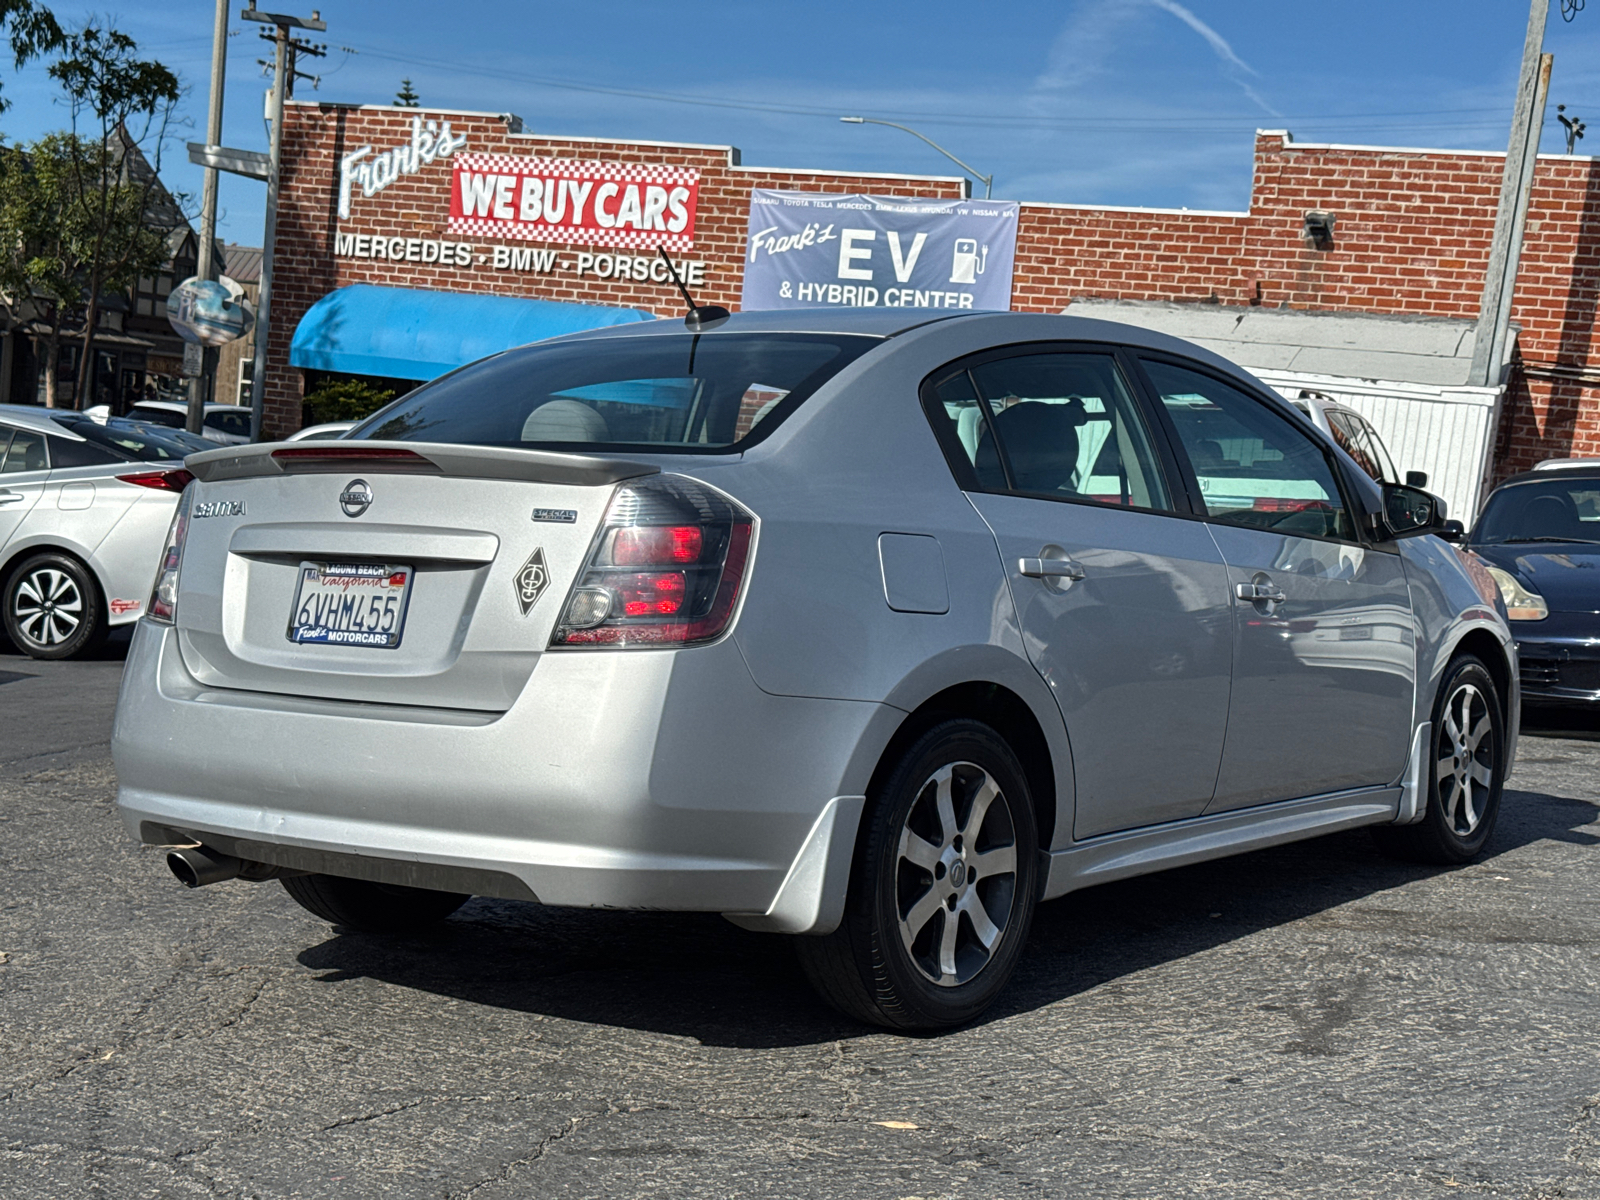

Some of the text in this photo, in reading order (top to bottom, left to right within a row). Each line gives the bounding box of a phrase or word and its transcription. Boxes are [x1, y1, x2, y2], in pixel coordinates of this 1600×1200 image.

[338, 116, 466, 220] Frank's
[460, 172, 691, 233] WE BUY CARS
[753, 197, 779, 206] SUBARU
[783, 199, 809, 207] TOYOTA
[836, 202, 872, 210] MERCEDES
[921, 207, 953, 215] HYUNDAI
[334, 233, 705, 285] MERCEDES BMW PORSCHE
[750, 223, 837, 263] Frank's
[779, 281, 974, 309] & HYBRID CENTER
[534, 509, 573, 517] SPECIAL
[326, 565, 385, 576] LAGUNA BEACH
[297, 592, 398, 632] 6VHM455
[328, 631, 388, 644] MOTORCARS
